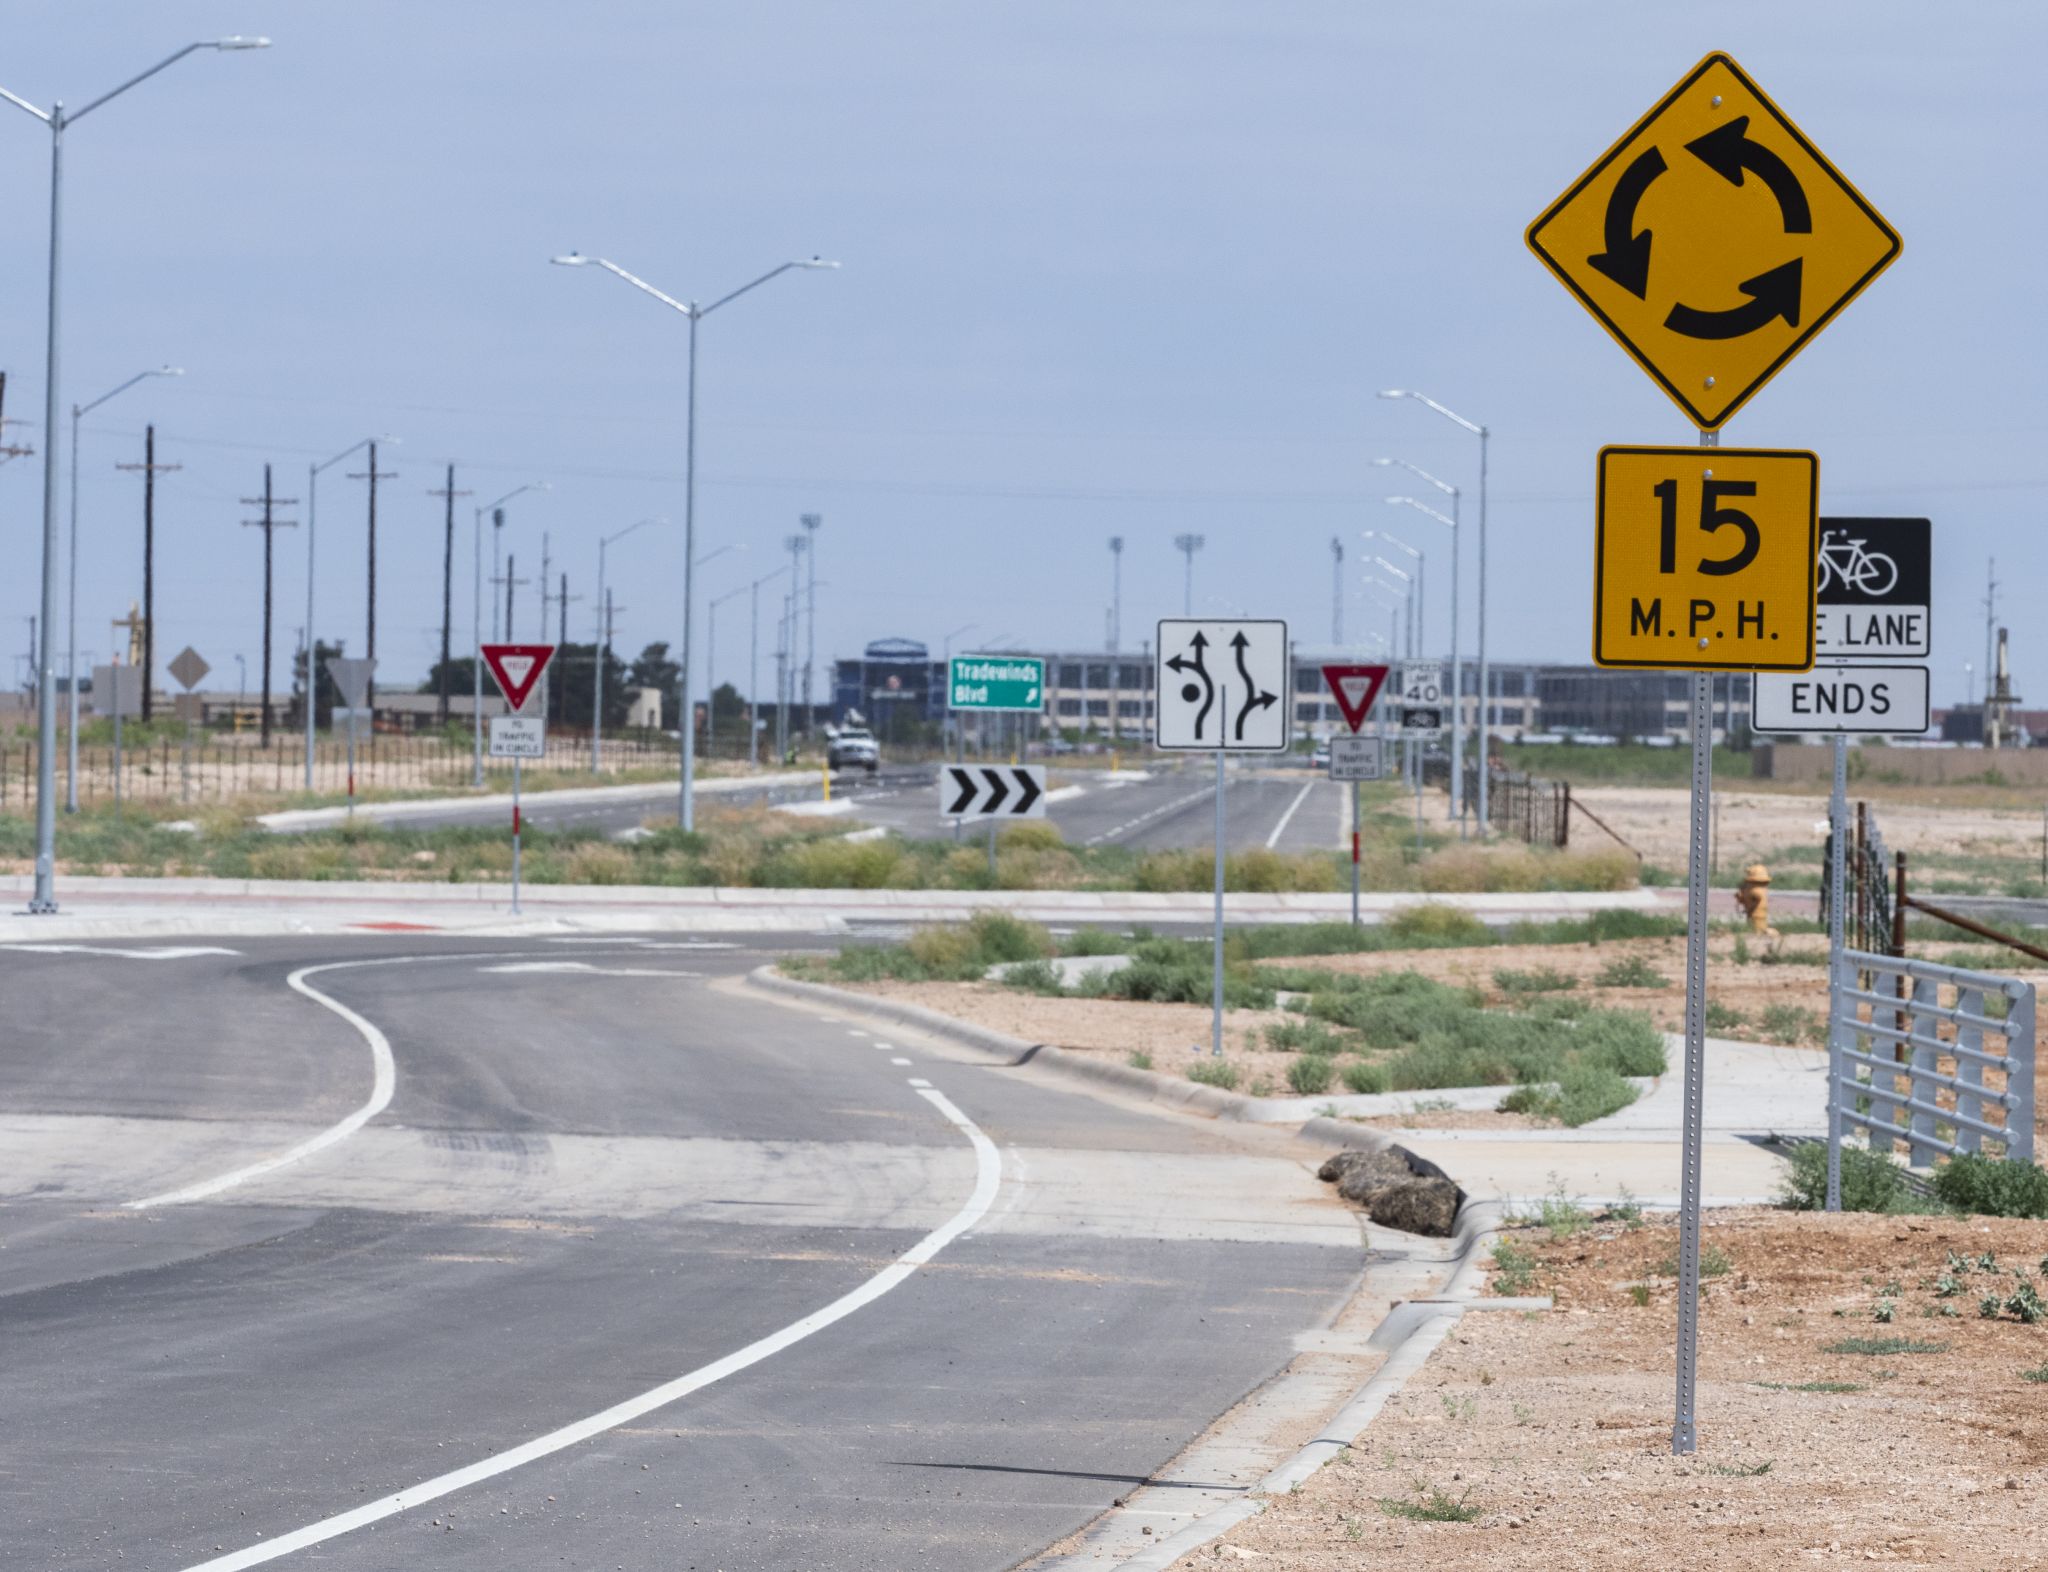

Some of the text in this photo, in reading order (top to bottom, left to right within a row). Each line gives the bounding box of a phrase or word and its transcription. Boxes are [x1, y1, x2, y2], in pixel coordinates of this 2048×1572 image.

[1654, 479, 1761, 576] 15
[1630, 597, 1778, 640] M.P.H.
[1845, 613, 1922, 646] LANE
[955, 661, 1038, 683] Tradewinds
[955, 684, 989, 704] Blvd
[1406, 684, 1440, 702] 40
[1791, 682, 1891, 715] ENDS
[499, 731, 536, 741] TRAFFIC
[506, 743, 539, 753] CIRCLE
[1338, 753, 1373, 763] TRAFFIC
